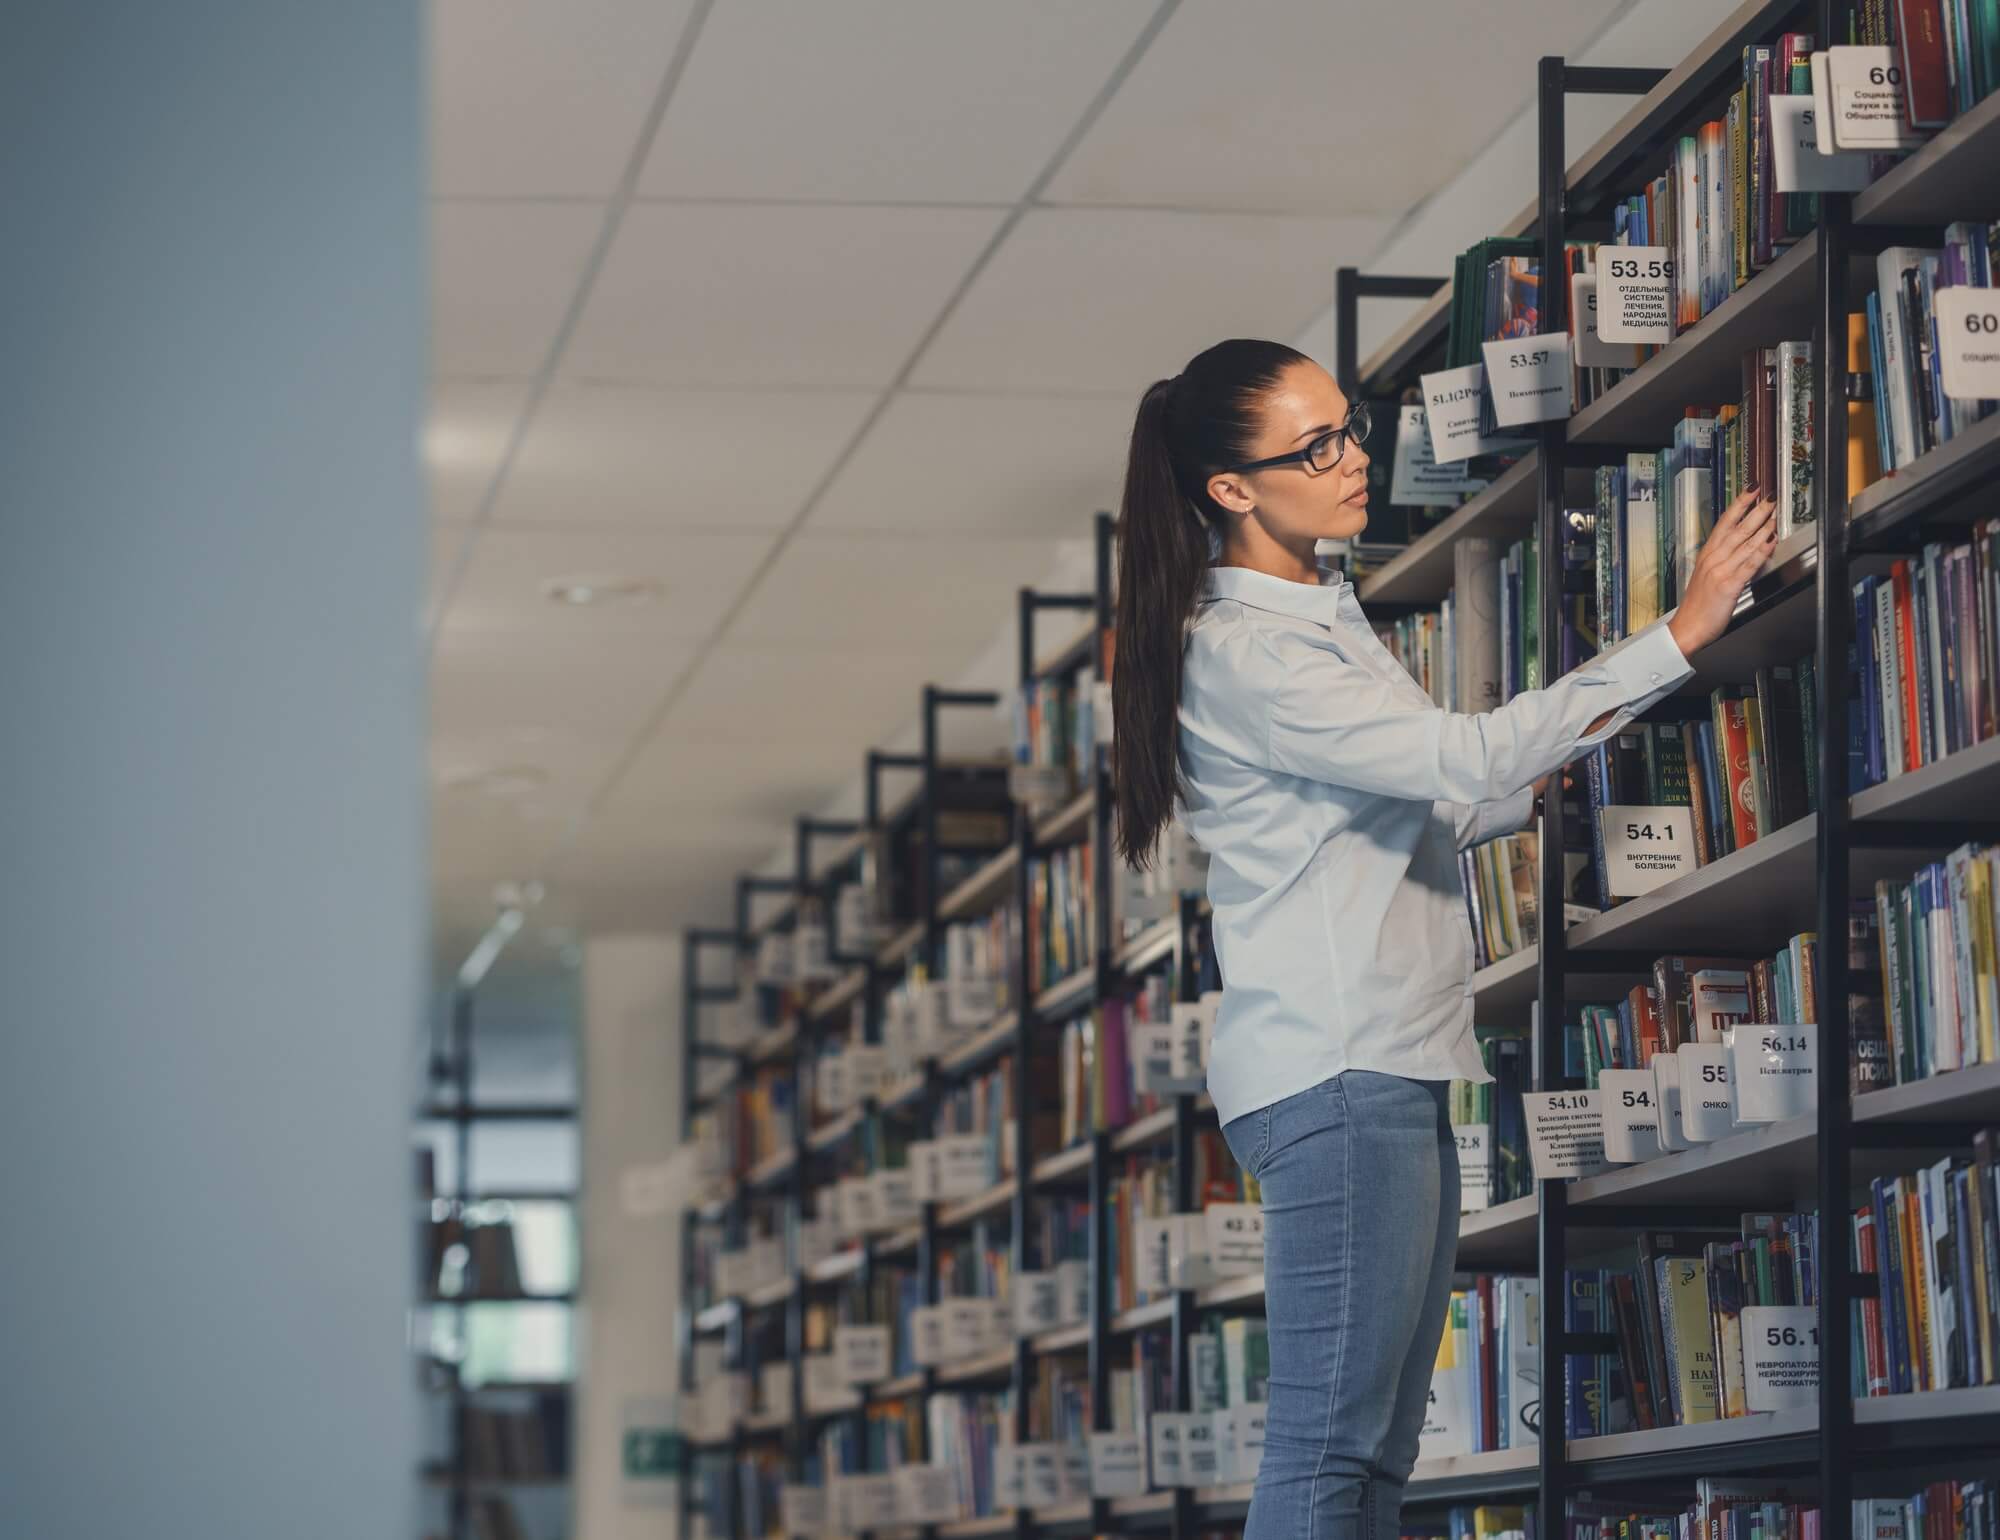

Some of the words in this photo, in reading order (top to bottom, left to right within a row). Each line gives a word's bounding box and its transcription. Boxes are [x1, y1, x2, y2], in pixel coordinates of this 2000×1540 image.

[1870, 67, 1901, 86] 60
[1611, 260, 1674, 279] 53.59
[1619, 285, 1671, 293] ОТДЕЛЬНЫЕ
[1624, 294, 1665, 302] СИСТЕМЫ
[1624, 303, 1665, 311] ЛЕЧЕНИЯ.
[1623, 312, 1667, 320] НАРОДНАЯ
[1622, 320, 1669, 328] МЕДИЦИНА
[1965, 313, 1998, 334] 60
[1510, 350, 1549, 368] 53.57
[1626, 824, 1675, 841] 54.1
[1626, 854, 1682, 862] ВНУТРЕННИЕ
[1634, 862, 1676, 870] БОЛЕЗНИ
[1762, 1036, 1808, 1052] 56.14
[1702, 1065, 1728, 1083] 55
[1548, 1095, 1589, 1111] 54.10
[1703, 1101, 1728, 1109] ОНКО
[1538, 1114, 1569, 1122] Болезни
[1628, 1124, 1657, 1132] ХИРУР
[1767, 1327, 1819, 1346] 56.1
